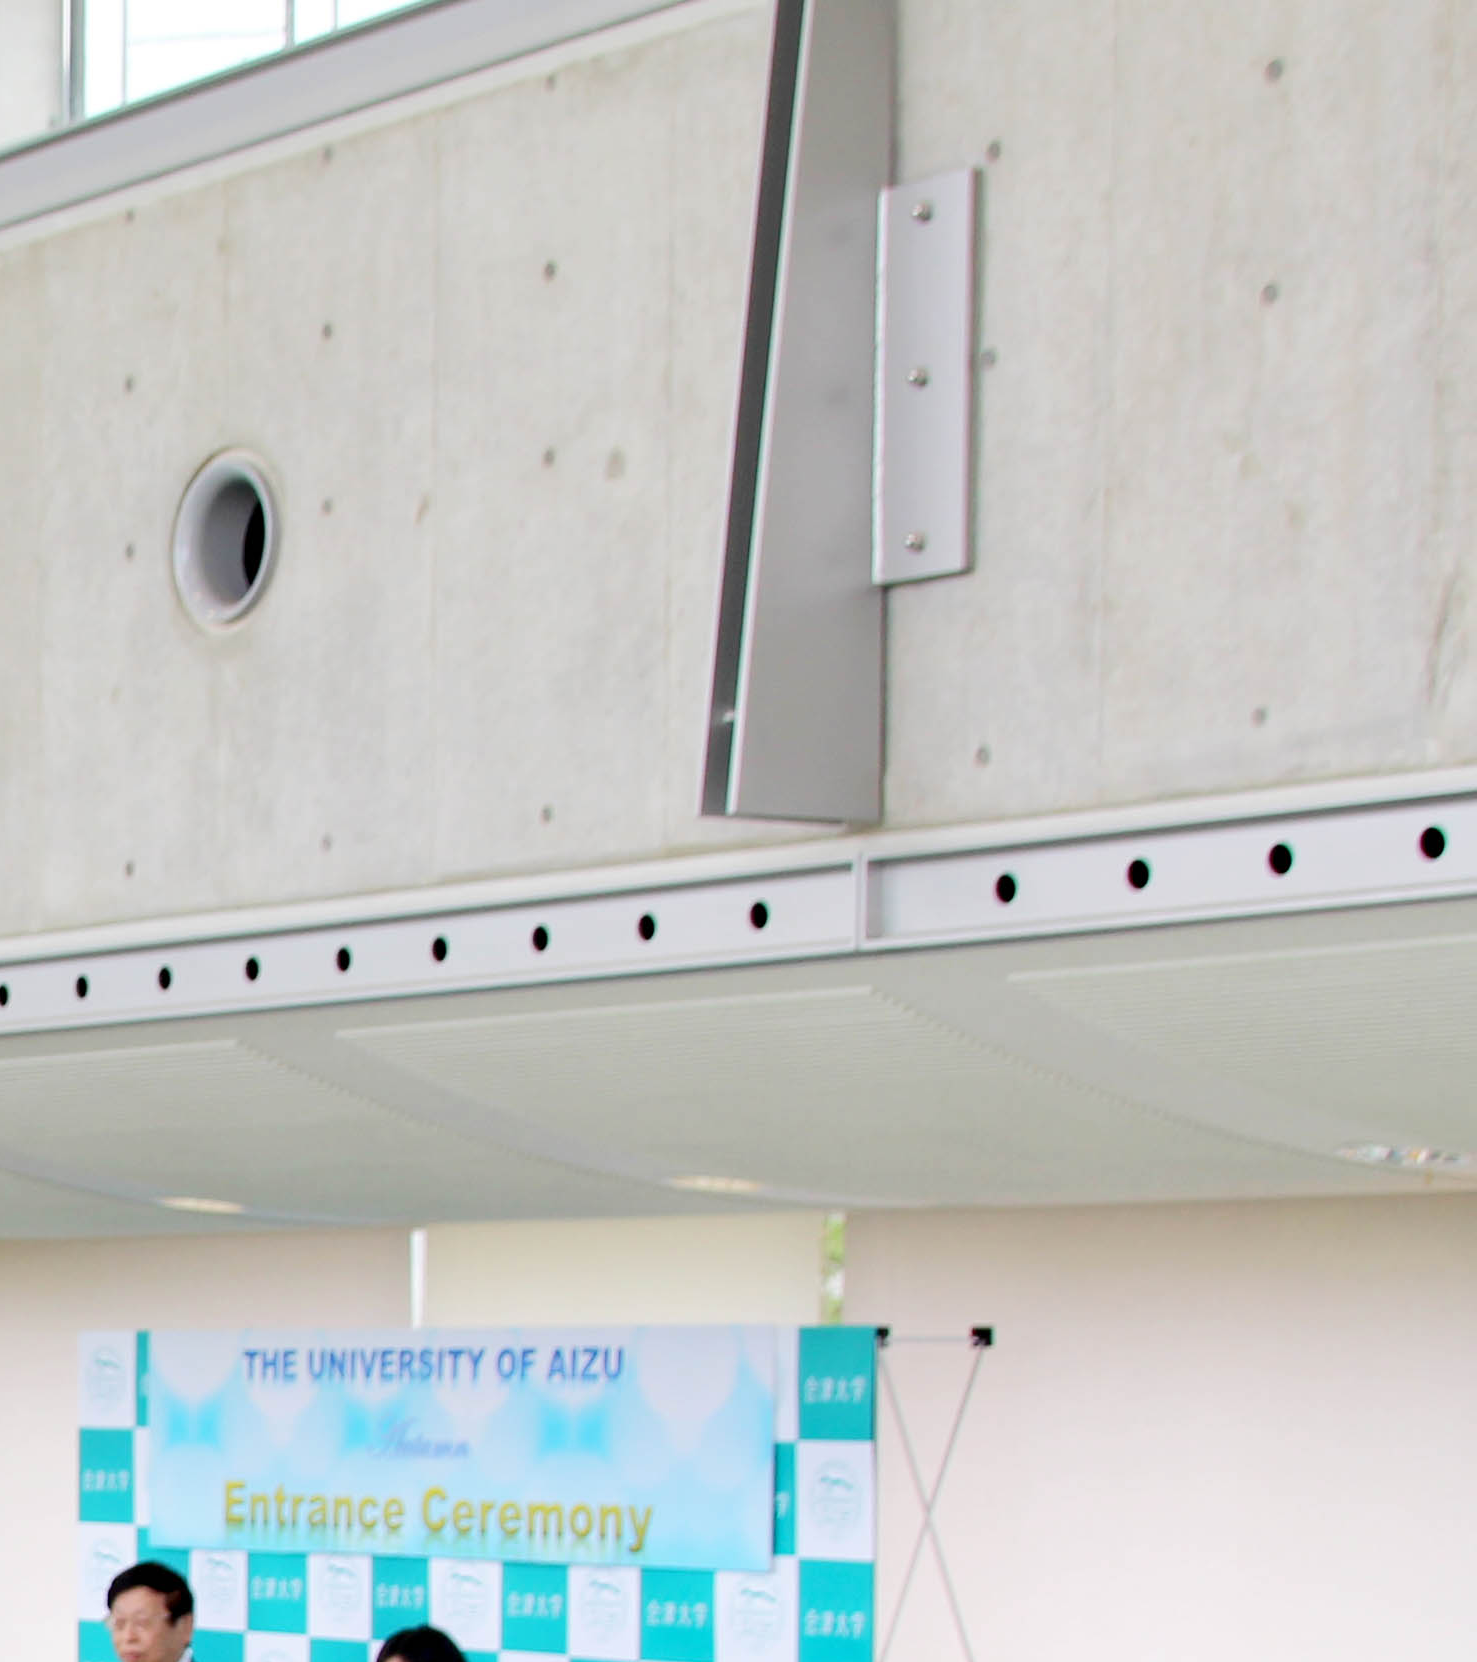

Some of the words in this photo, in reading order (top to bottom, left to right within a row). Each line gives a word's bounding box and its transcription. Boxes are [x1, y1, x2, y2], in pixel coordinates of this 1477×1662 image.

[242, 1347, 297, 1381] THE
[308, 1346, 486, 1382] UNIVERSITY
[496, 1347, 538, 1381] OF
[547, 1346, 625, 1381] AIZU
[223, 1480, 405, 1531] Entrance
[421, 1486, 653, 1552] Ceremony
